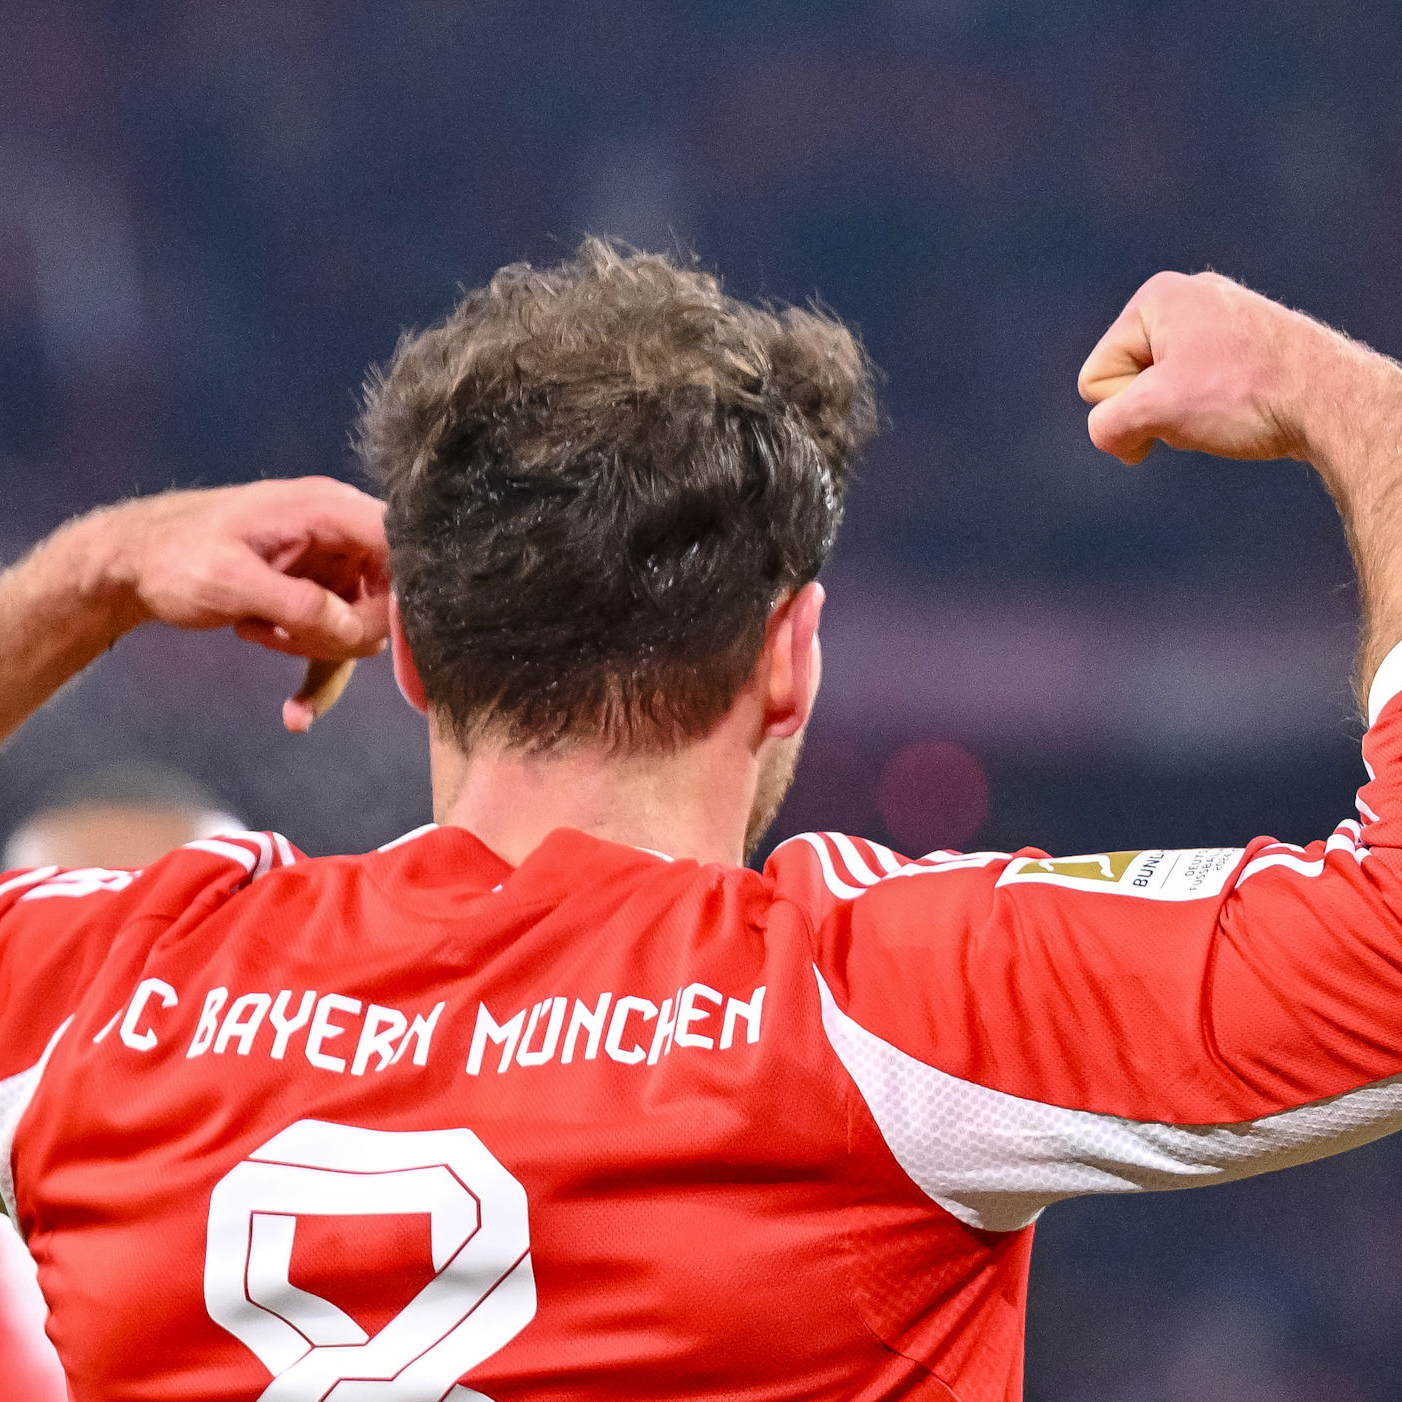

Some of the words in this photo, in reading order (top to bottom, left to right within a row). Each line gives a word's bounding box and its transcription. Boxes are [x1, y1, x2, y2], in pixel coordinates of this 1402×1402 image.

[92, 976, 179, 1052] C
[185, 985, 447, 1076] BAYERN
[465, 982, 767, 1077] MÜNCHEN
